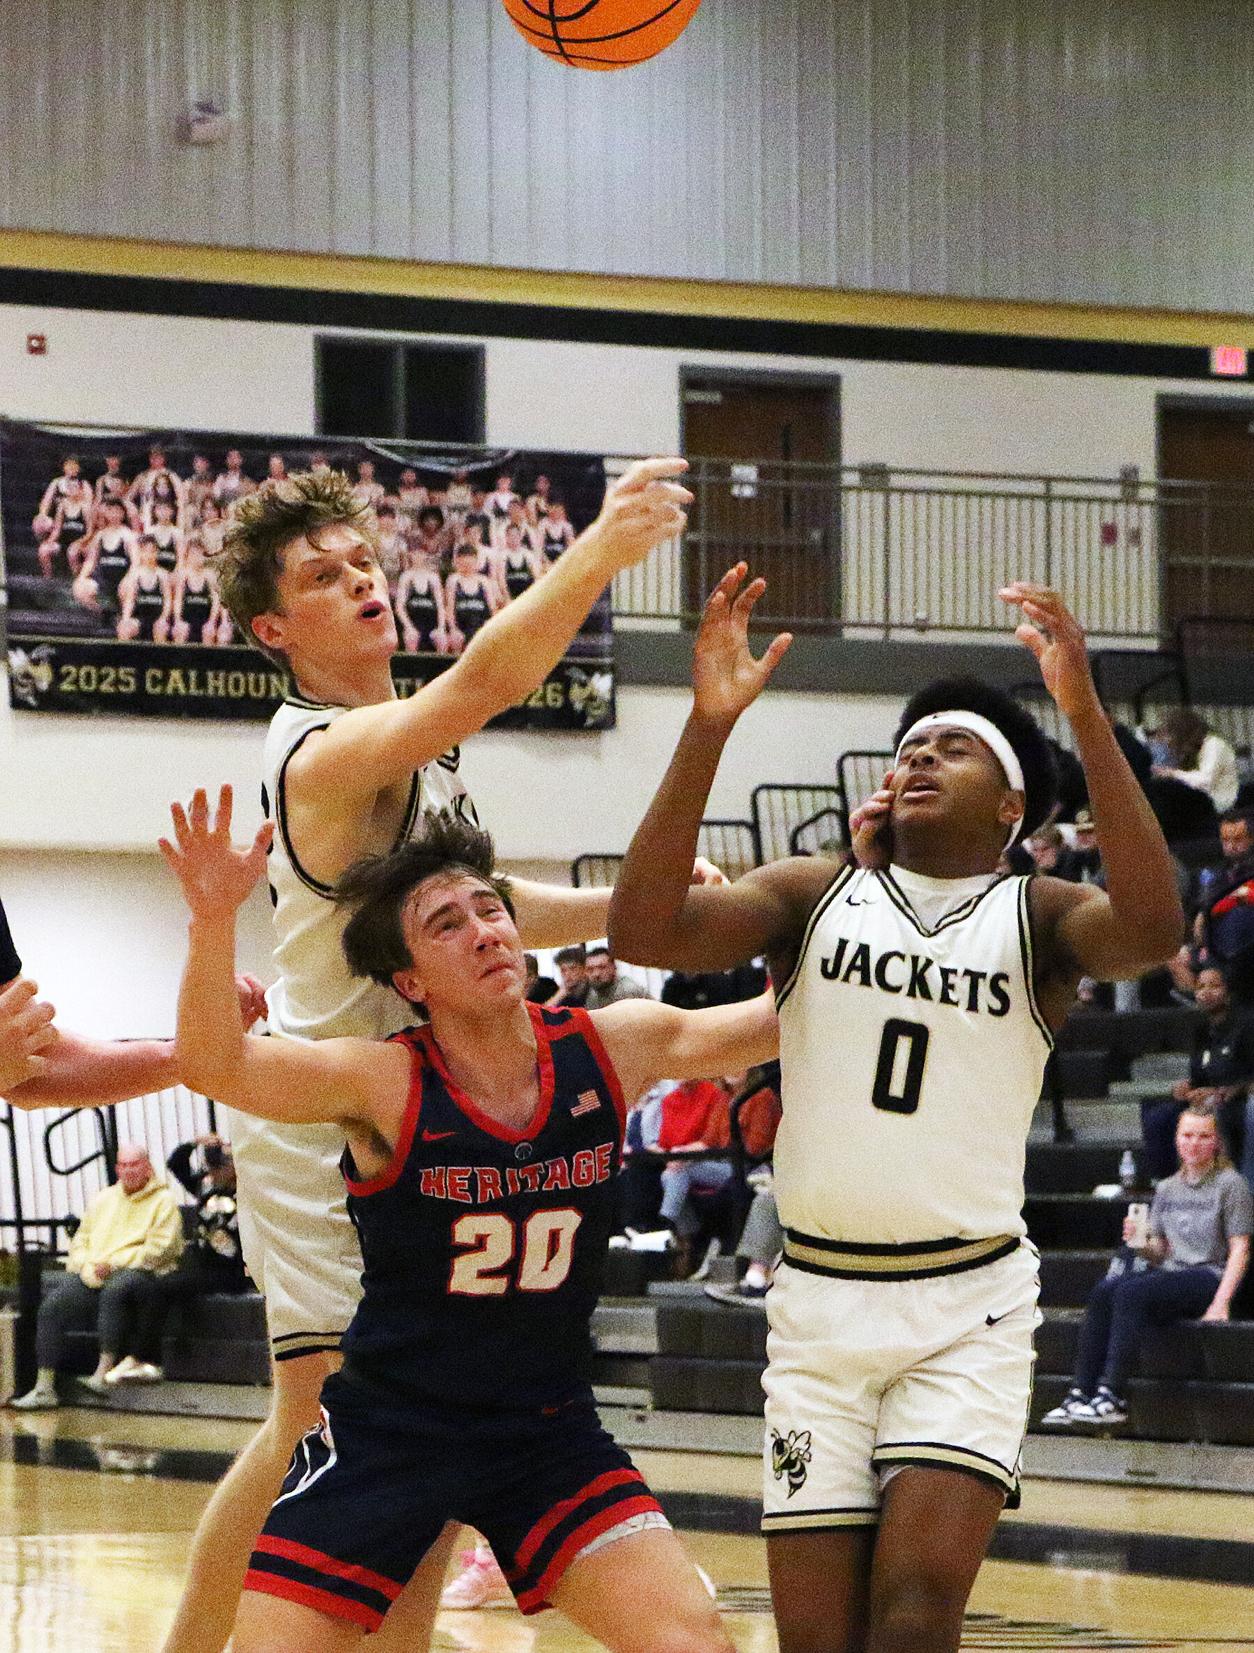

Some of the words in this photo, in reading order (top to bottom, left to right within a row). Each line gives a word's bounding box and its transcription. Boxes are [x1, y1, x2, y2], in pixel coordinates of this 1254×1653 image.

[58, 664, 137, 694] 2025
[144, 668, 290, 698] CALHOUN
[820, 937, 1011, 1017] JACKETS
[871, 1017, 930, 1115] 0
[418, 1141, 615, 1204] HERITAGE
[446, 1206, 584, 1298] 20
